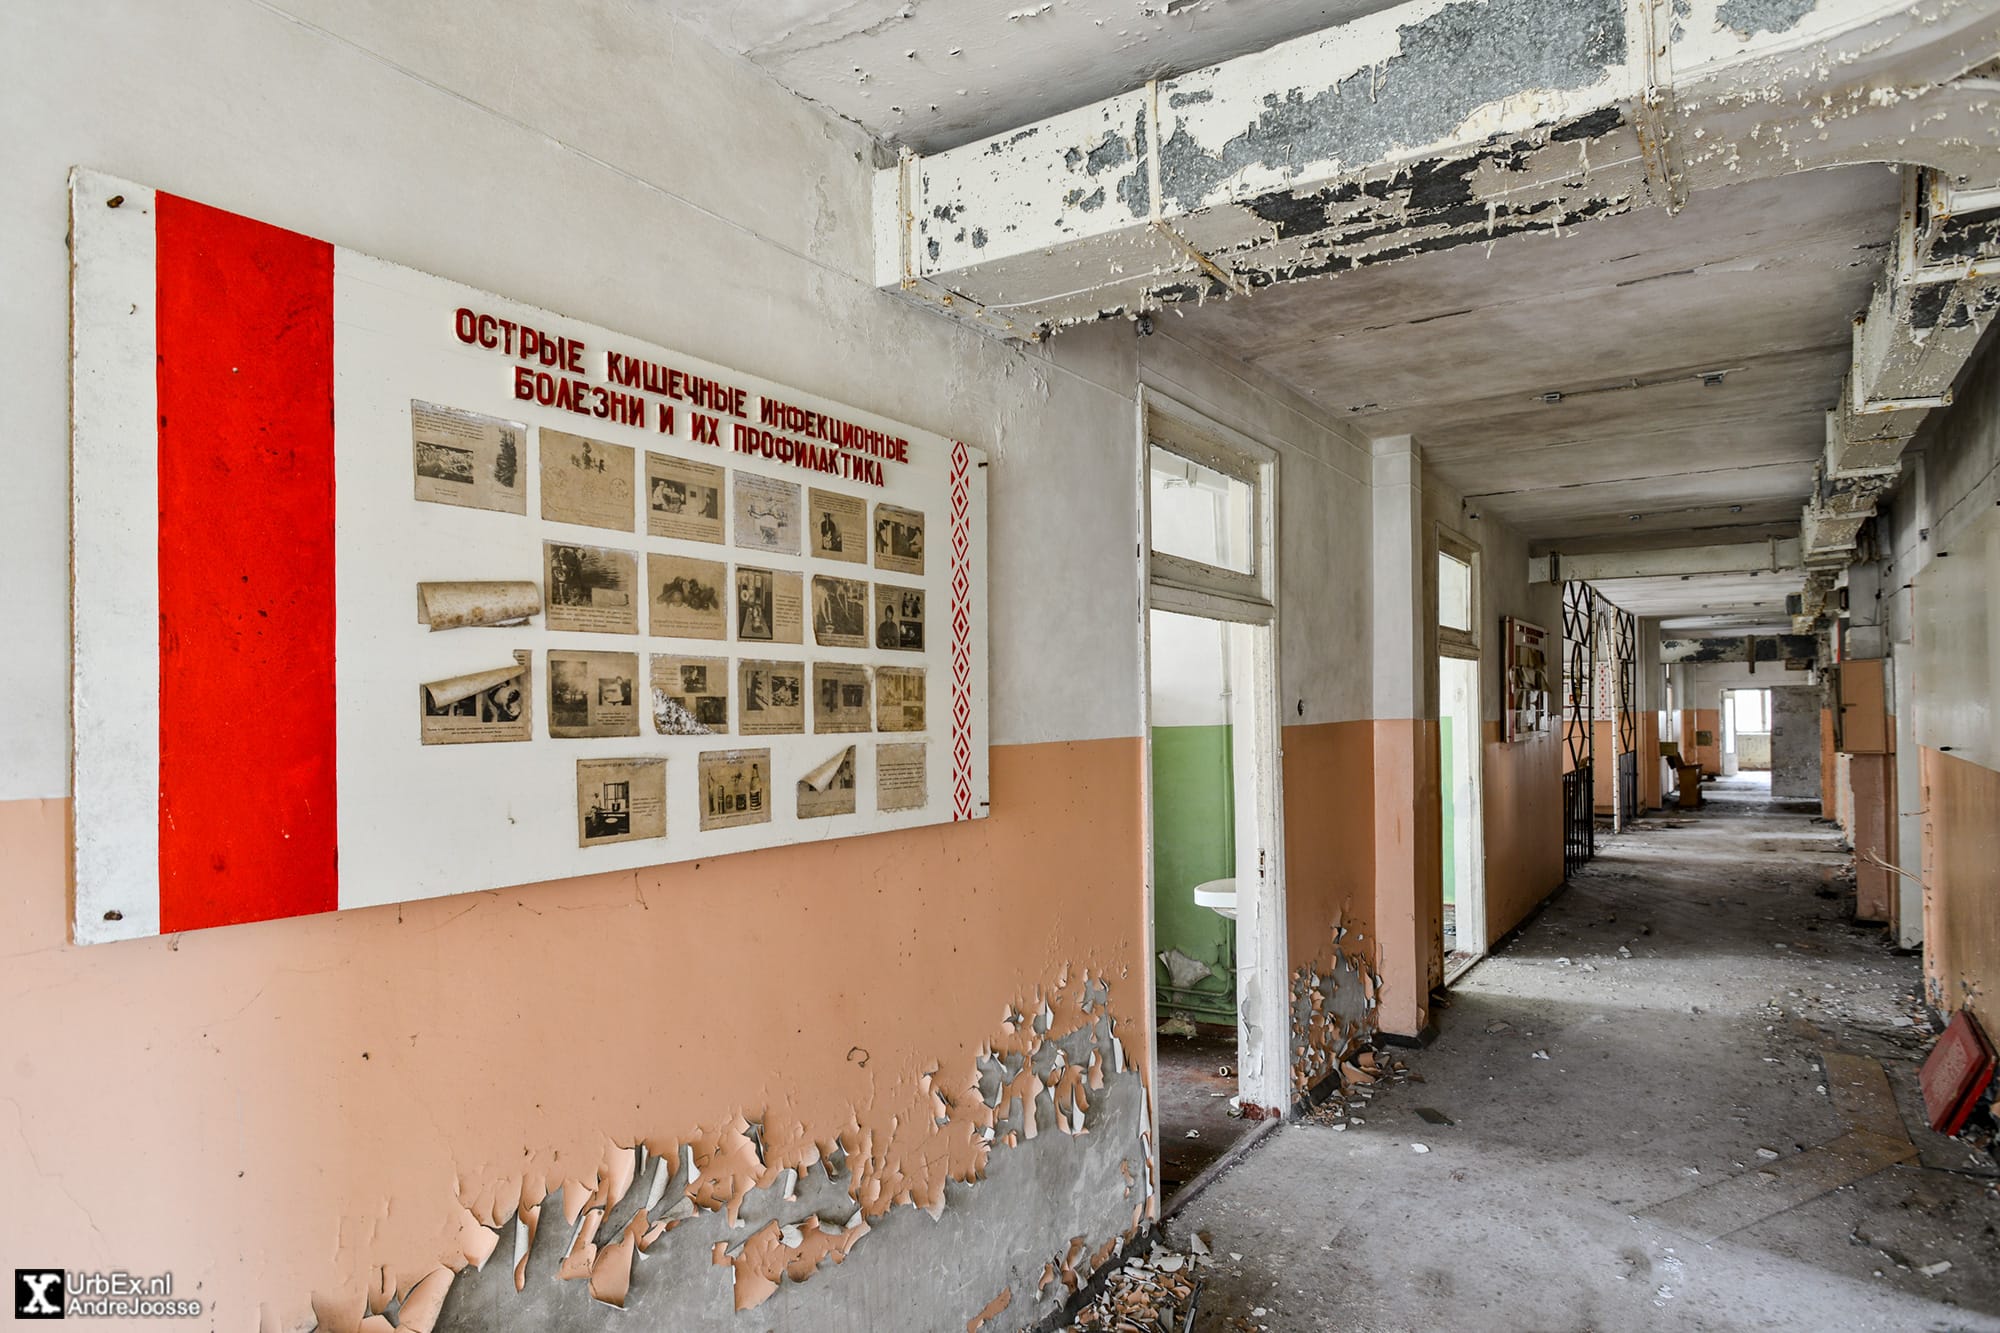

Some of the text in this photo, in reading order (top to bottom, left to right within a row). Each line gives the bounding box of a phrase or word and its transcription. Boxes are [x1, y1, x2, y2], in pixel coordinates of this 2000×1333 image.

[455, 307, 909, 464] ОСТРЫЕ КИШЕЧНЫЕ ИНФЕКЦИОННЫЕ
[514, 365, 645, 428] БОЛЕЗНИ
[658, 402, 674, 435] И
[691, 412, 720, 447] ИХ
[733, 423, 884, 487] ПРОФИЛАКТИКА
